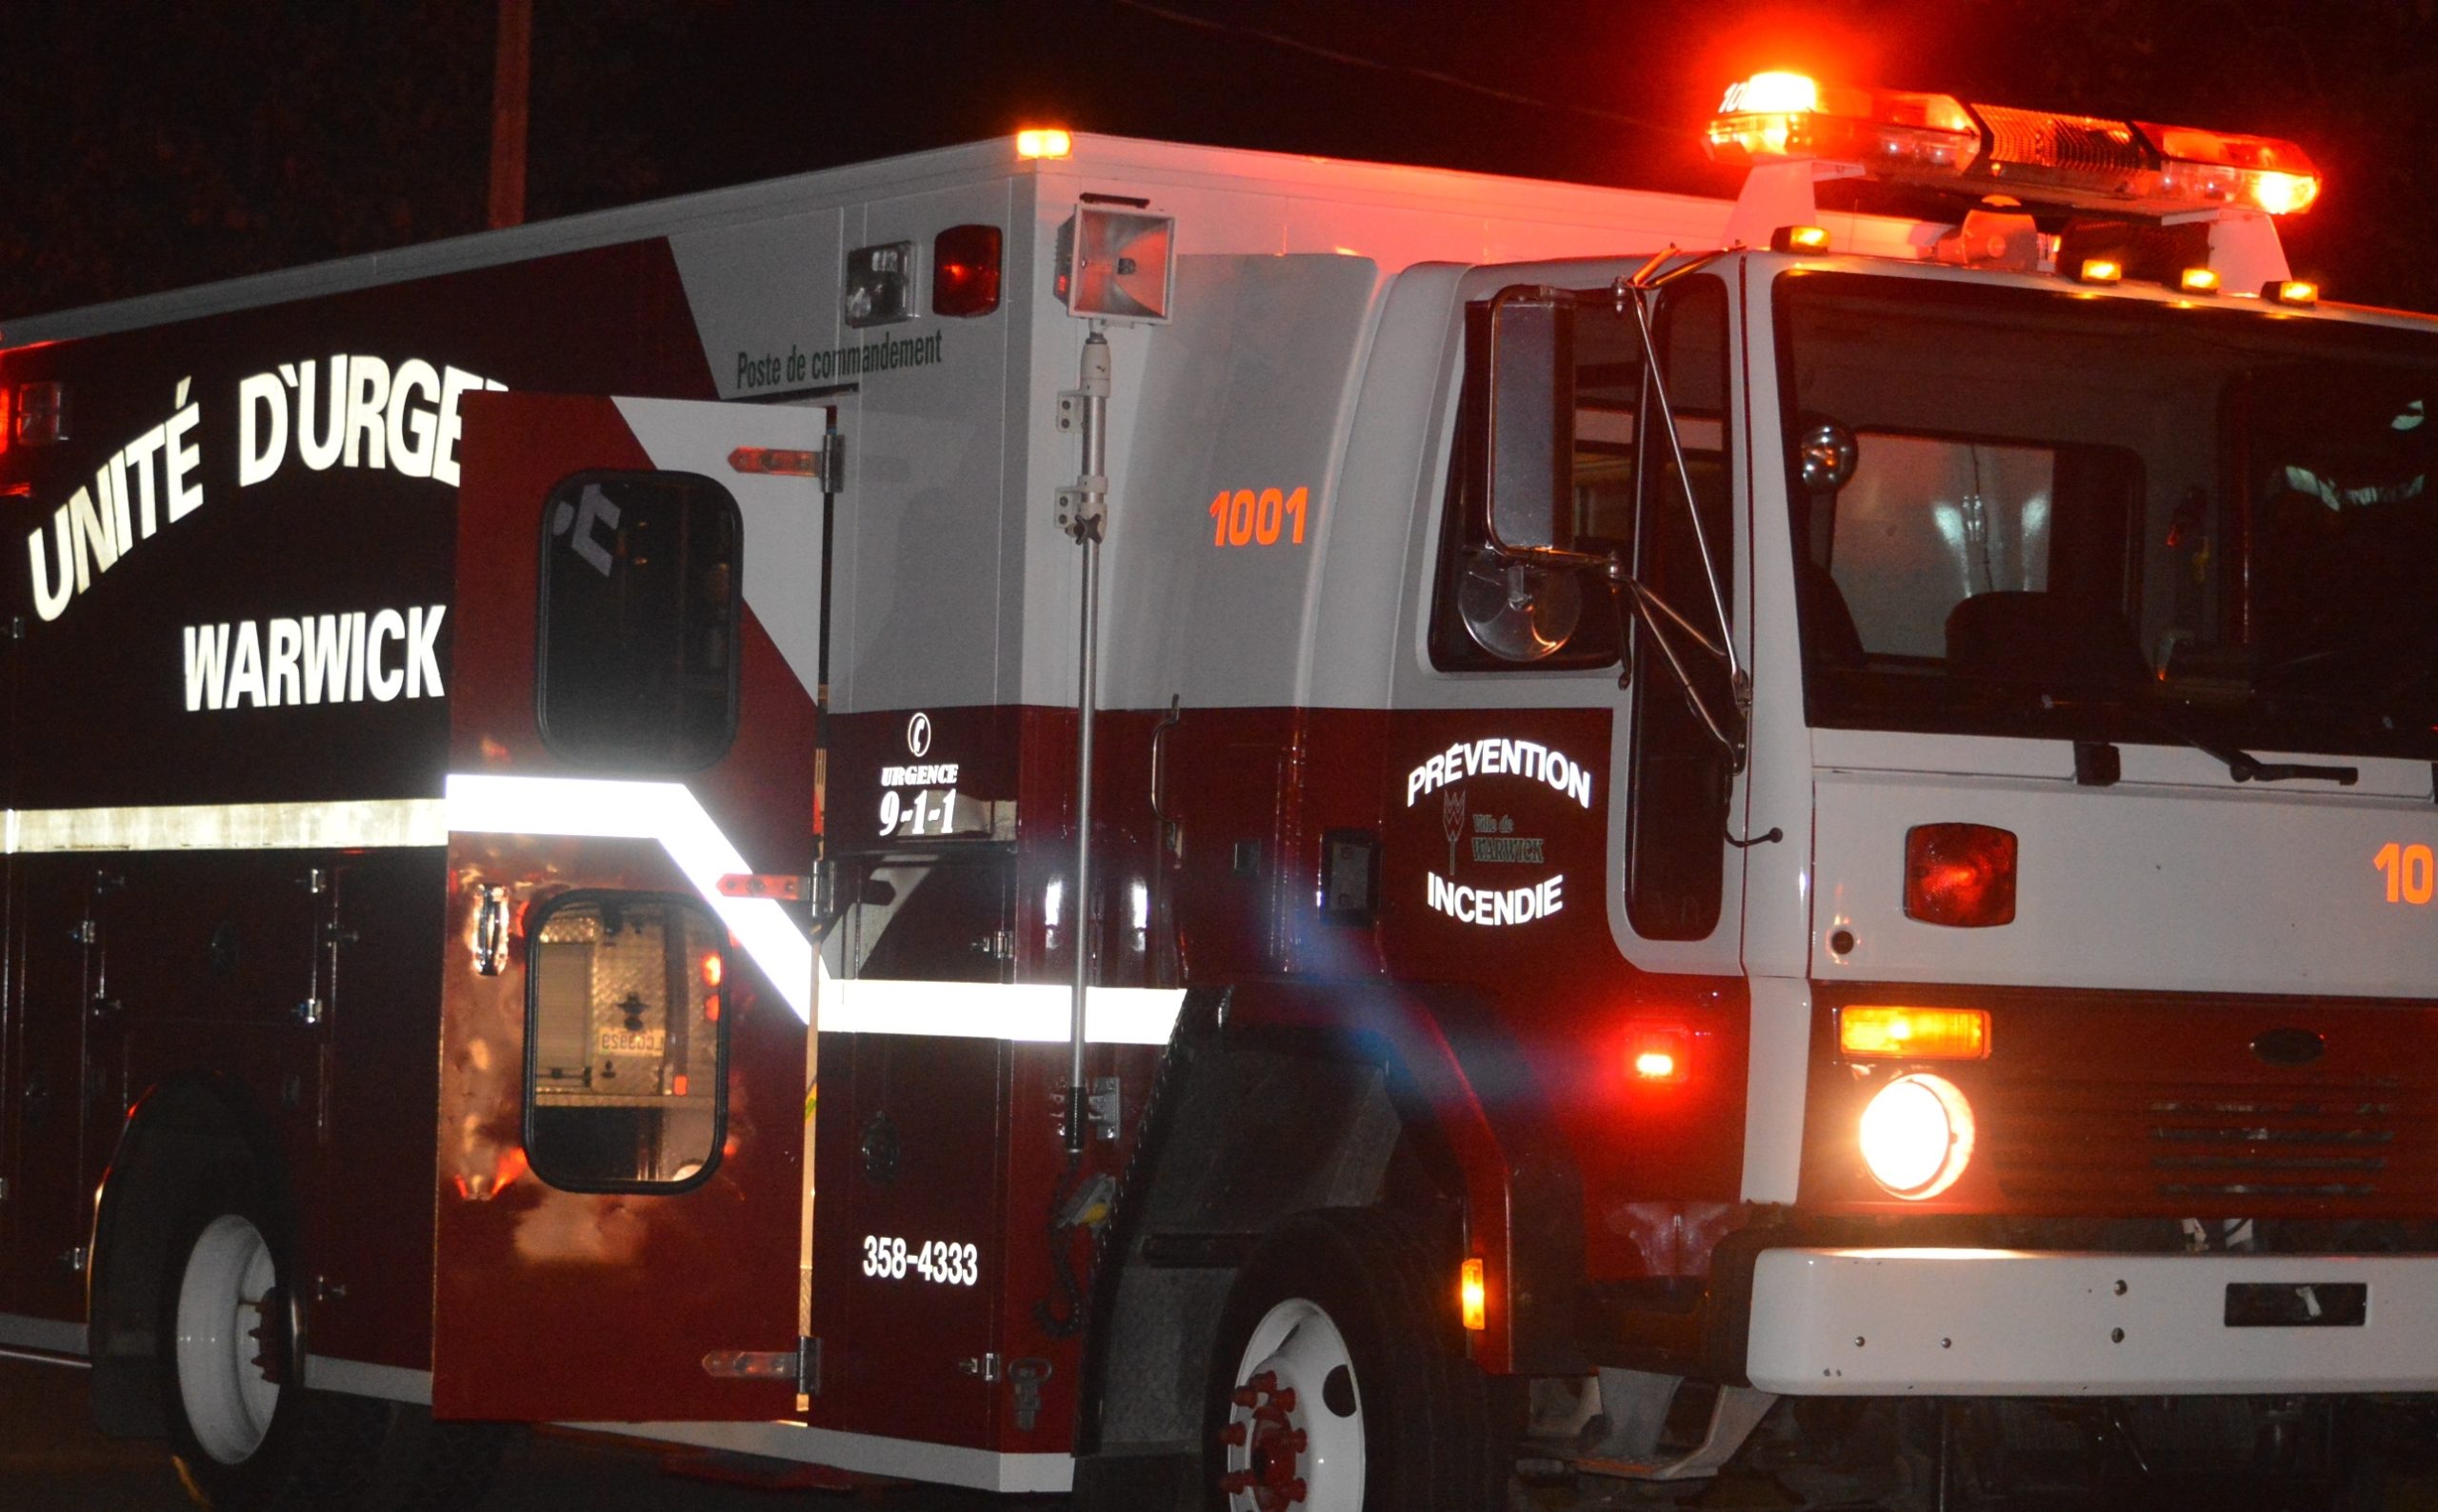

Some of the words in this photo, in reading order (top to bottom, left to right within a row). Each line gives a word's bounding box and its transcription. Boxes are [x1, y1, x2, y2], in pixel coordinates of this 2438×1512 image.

[737, 352, 782, 388] Poste
[787, 345, 806, 382] de
[812, 328, 942, 379] commandement
[29, 376, 203, 621] UNITÉ
[240, 354, 509, 487] D'URGE
[1209, 487, 1309, 547] 1001
[184, 605, 446, 711] WARWICK
[881, 764, 958, 786] URGENCE
[1408, 738, 1590, 808] PRÉVENTION
[879, 788, 956, 836] 9-1-1
[1472, 838, 1544, 863] WARWICK
[2373, 842, 2434, 905] 10
[1428, 871, 1563, 925] INCENDIE
[863, 1235, 977, 1285] 358-4333
